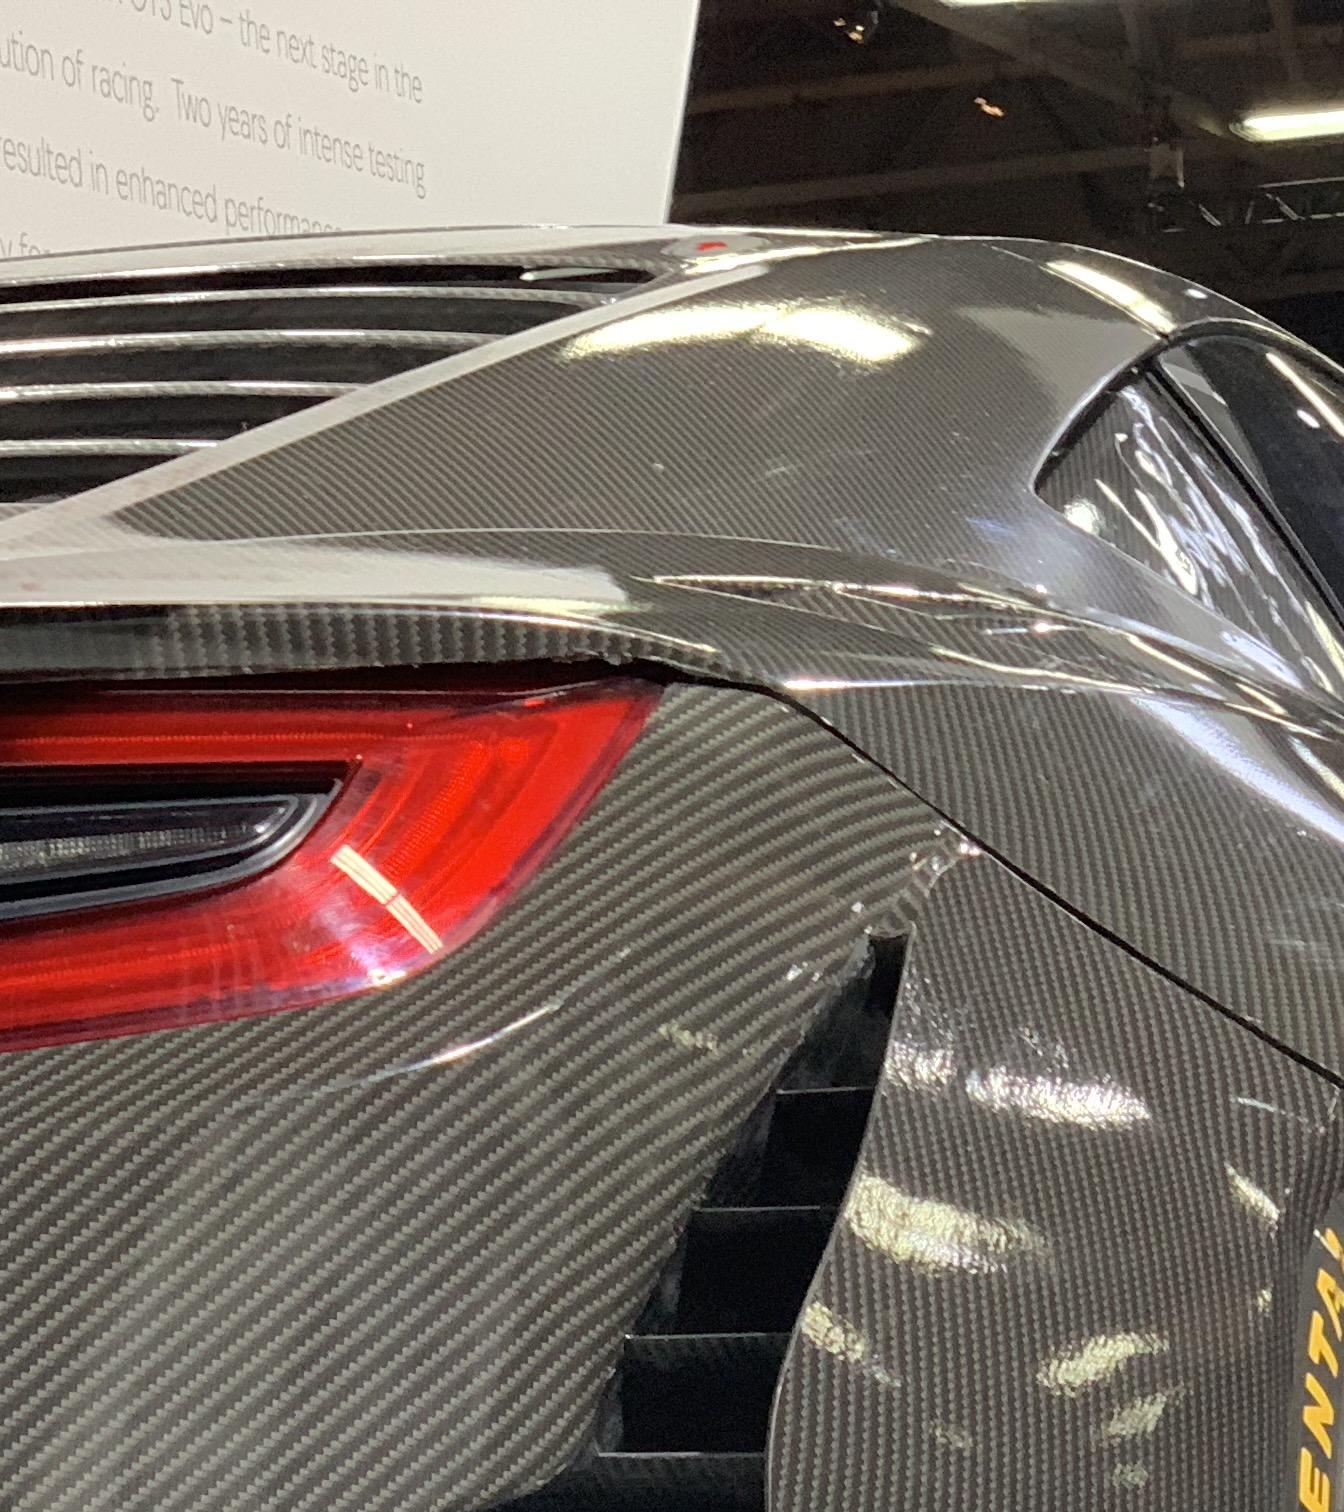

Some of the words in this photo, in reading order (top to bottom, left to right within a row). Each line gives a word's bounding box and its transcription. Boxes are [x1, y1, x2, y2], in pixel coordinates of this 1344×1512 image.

[238, 9, 271, 54] the
[277, 30, 318, 69] next
[322, 43, 369, 93] stage
[374, 53, 389, 93] in
[394, 63, 423, 104] the
[62, 49, 84, 91] of
[91, 61, 159, 122] racing.
[171, 78, 212, 127] Two
[217, 102, 268, 145] years
[274, 113, 293, 150] of
[298, 116, 364, 172] intense
[368, 142, 426, 200] testing
[89, 150, 109, 195] in
[116, 167, 218, 223] enhanced
[224, 197, 343, 236] performa
